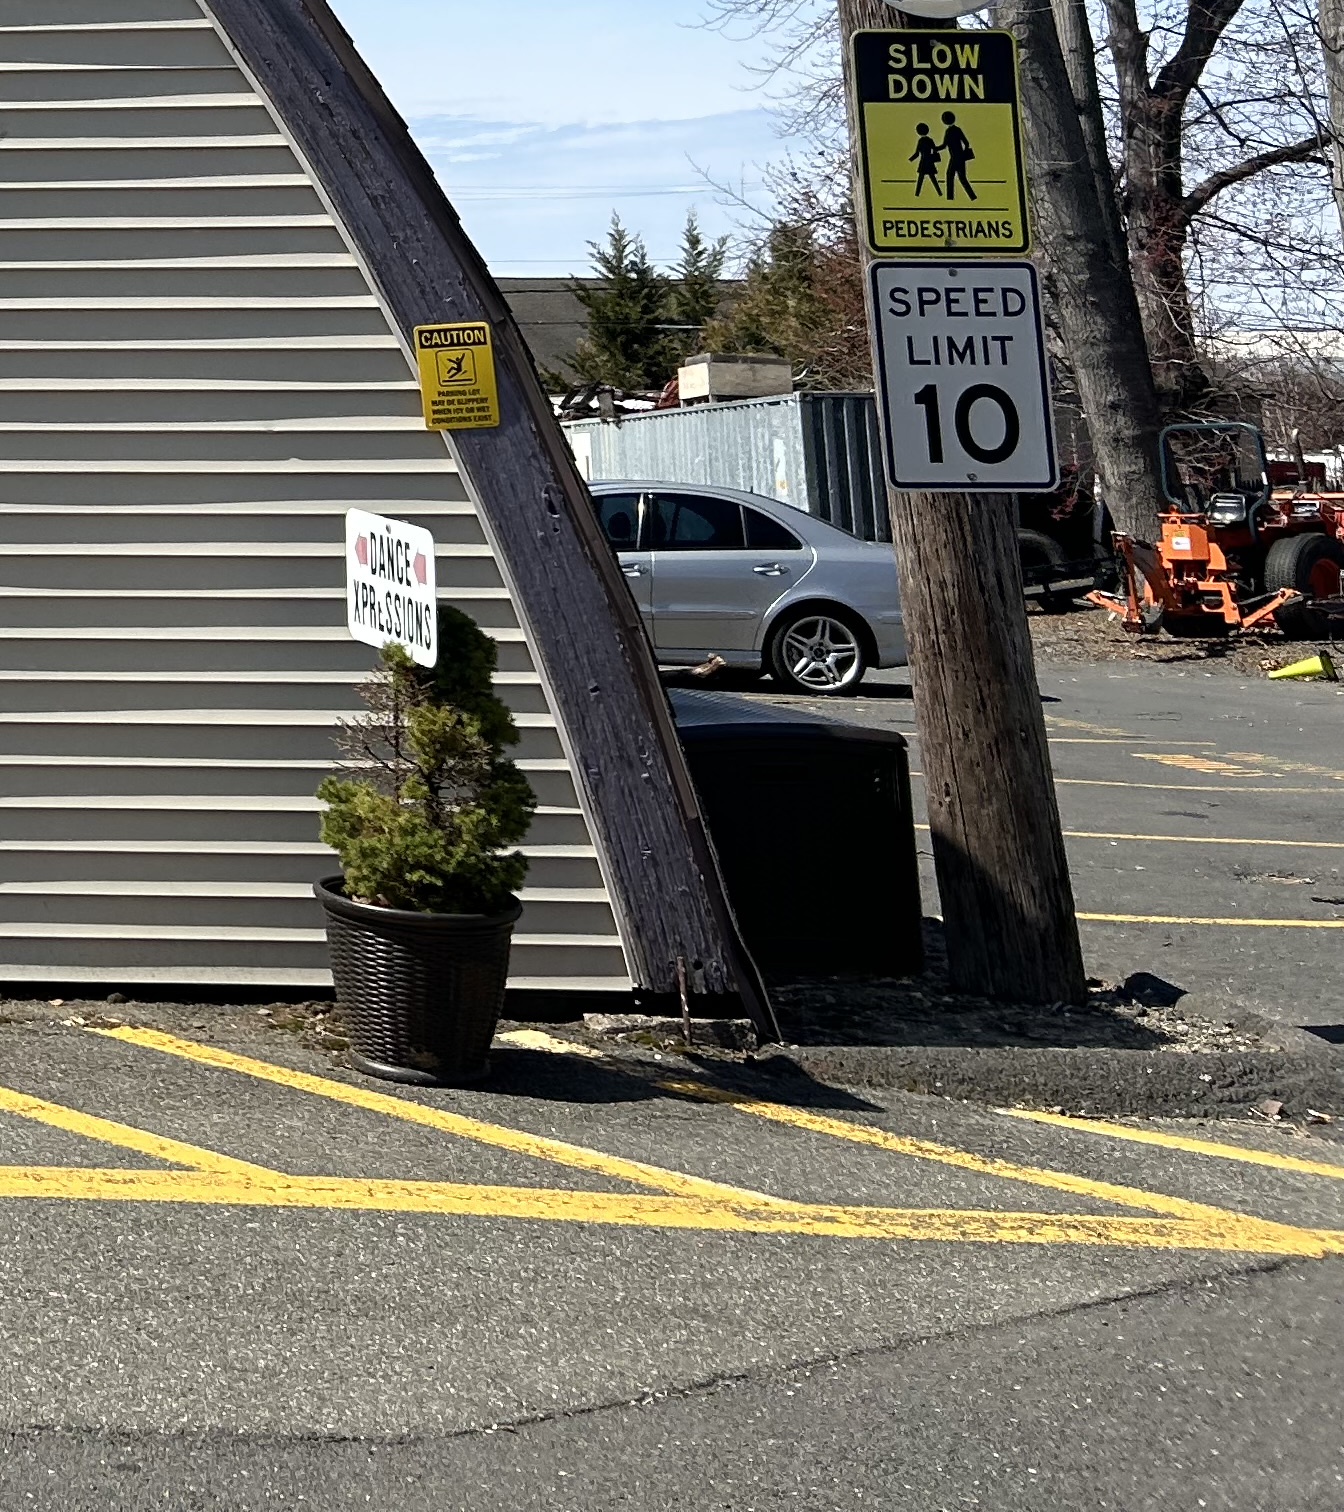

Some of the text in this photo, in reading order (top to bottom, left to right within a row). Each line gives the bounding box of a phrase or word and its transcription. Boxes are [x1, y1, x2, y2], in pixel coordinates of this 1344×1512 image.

[888, 43, 981, 69] SLOW
[887, 74, 985, 100] DOWN
[882, 219, 1013, 240] PEDESTRIANS
[888, 287, 1026, 318] SPEED
[421, 329, 485, 346] CAUTION
[906, 335, 1014, 366] LIMIT
[914, 383, 1020, 465] 10
[370, 531, 412, 587] DANCE
